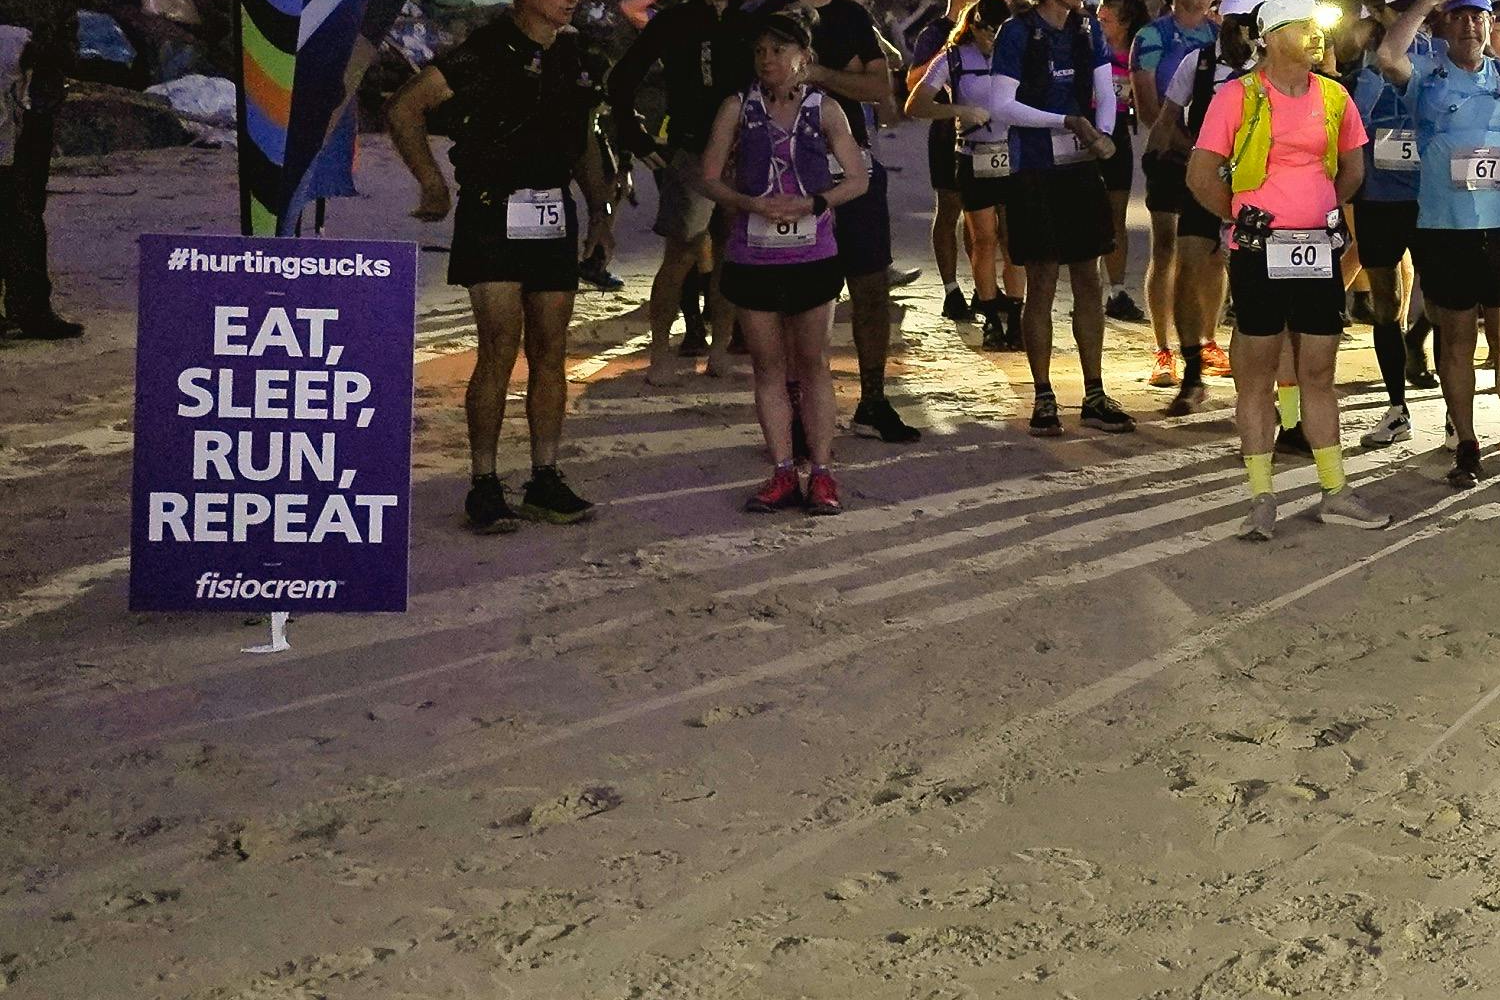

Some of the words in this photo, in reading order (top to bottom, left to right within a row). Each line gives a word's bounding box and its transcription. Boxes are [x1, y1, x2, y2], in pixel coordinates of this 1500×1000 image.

[990, 153, 1008, 169] 62
[1401, 142, 1412, 159] 5
[1475, 160, 1497, 178] 67
[535, 205, 559, 226] 75
[167, 248, 391, 280] #hurtingsucks
[1291, 245, 1317, 266] 60
[213, 306, 345, 366] EAT,
[177, 368, 376, 428] SLEEP,
[192, 430, 357, 489] RUN,
[148, 492, 398, 544] REPEAT
[195, 572, 338, 600] fisiocrem
